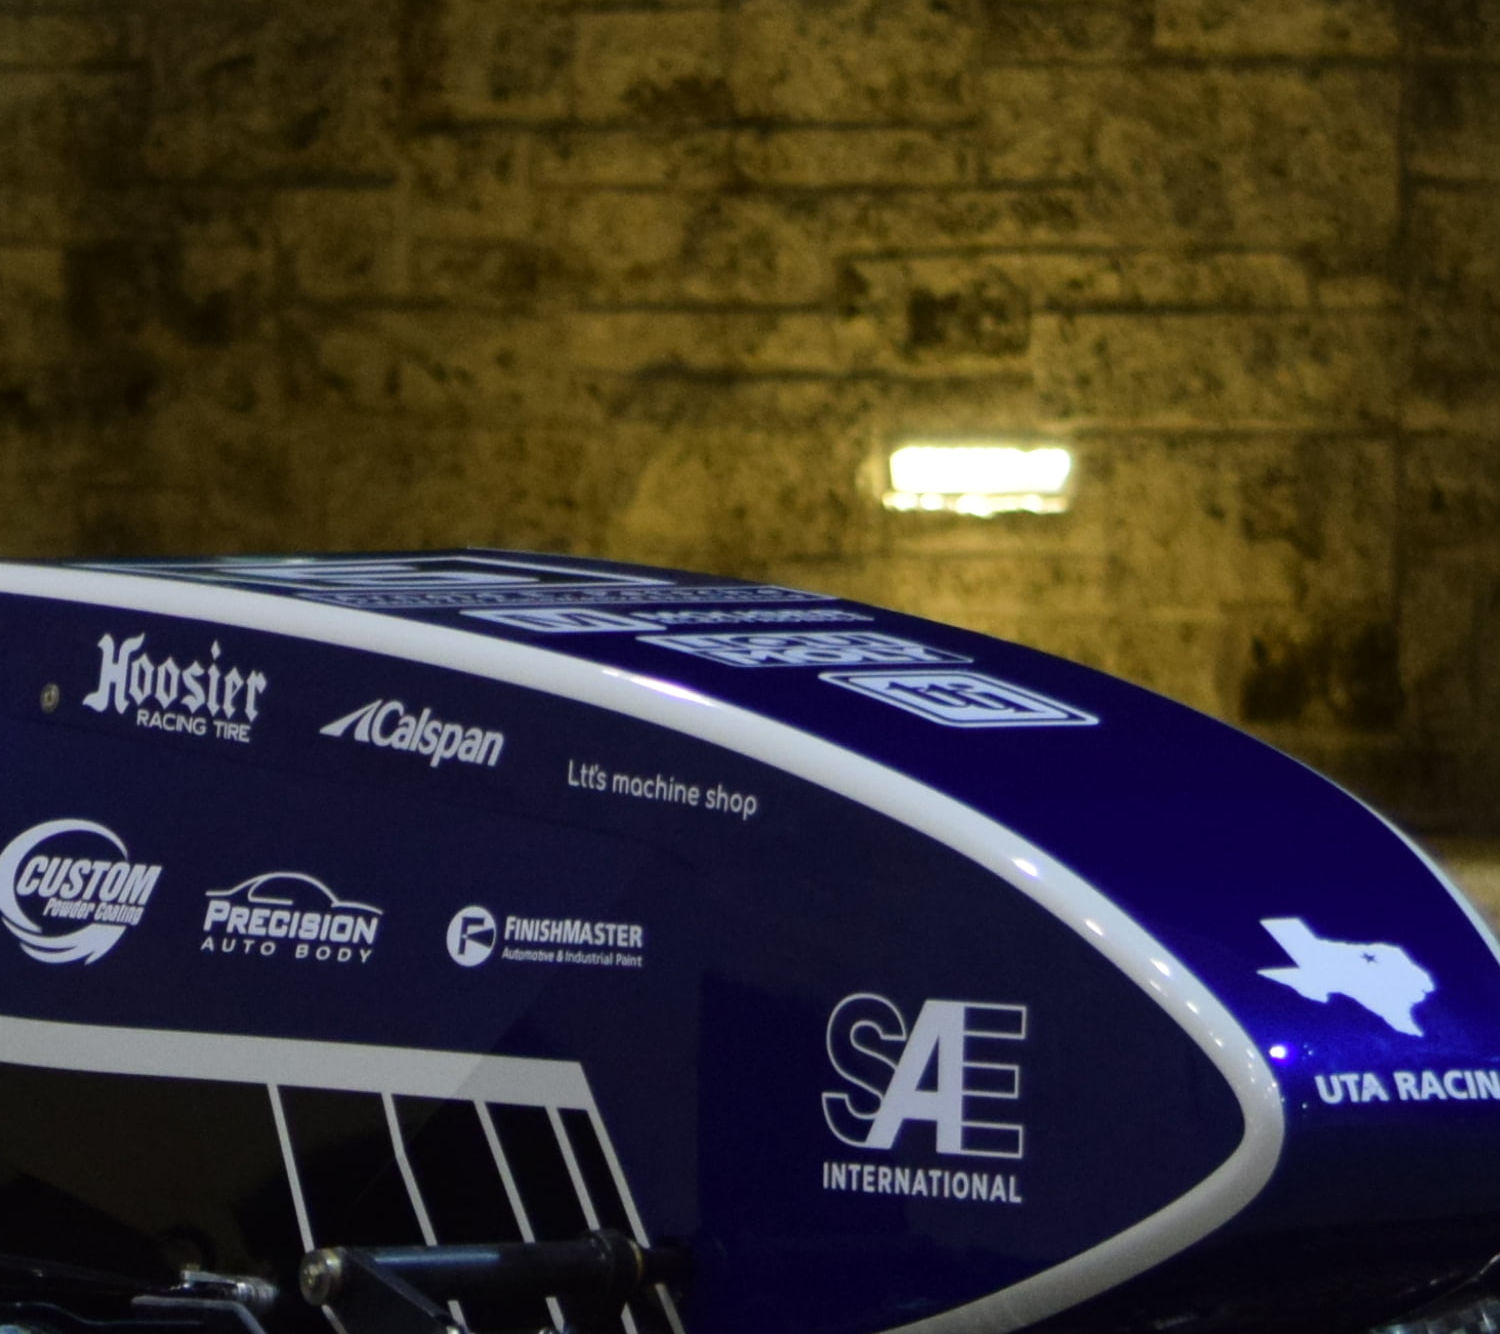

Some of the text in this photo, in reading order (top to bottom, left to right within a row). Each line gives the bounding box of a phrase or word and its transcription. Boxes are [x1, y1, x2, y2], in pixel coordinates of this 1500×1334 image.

[82, 632, 268, 722] Hoosier
[136, 709, 251, 743] RACING TIRE
[371, 700, 503, 767] Calspan
[612, 774, 700, 806] machine
[705, 783, 757, 820] shop
[16, 855, 162, 905] CUSTOM
[43, 897, 144, 926] Powder Coating
[203, 900, 378, 944] PRECISION
[200, 936, 374, 964] AUTO BODY
[614, 953, 643, 968] Paint
[821, 993, 1027, 1159] SAE
[1316, 1072, 1389, 1105] UTA
[822, 1162, 1022, 1204] INTERNATIONAL
